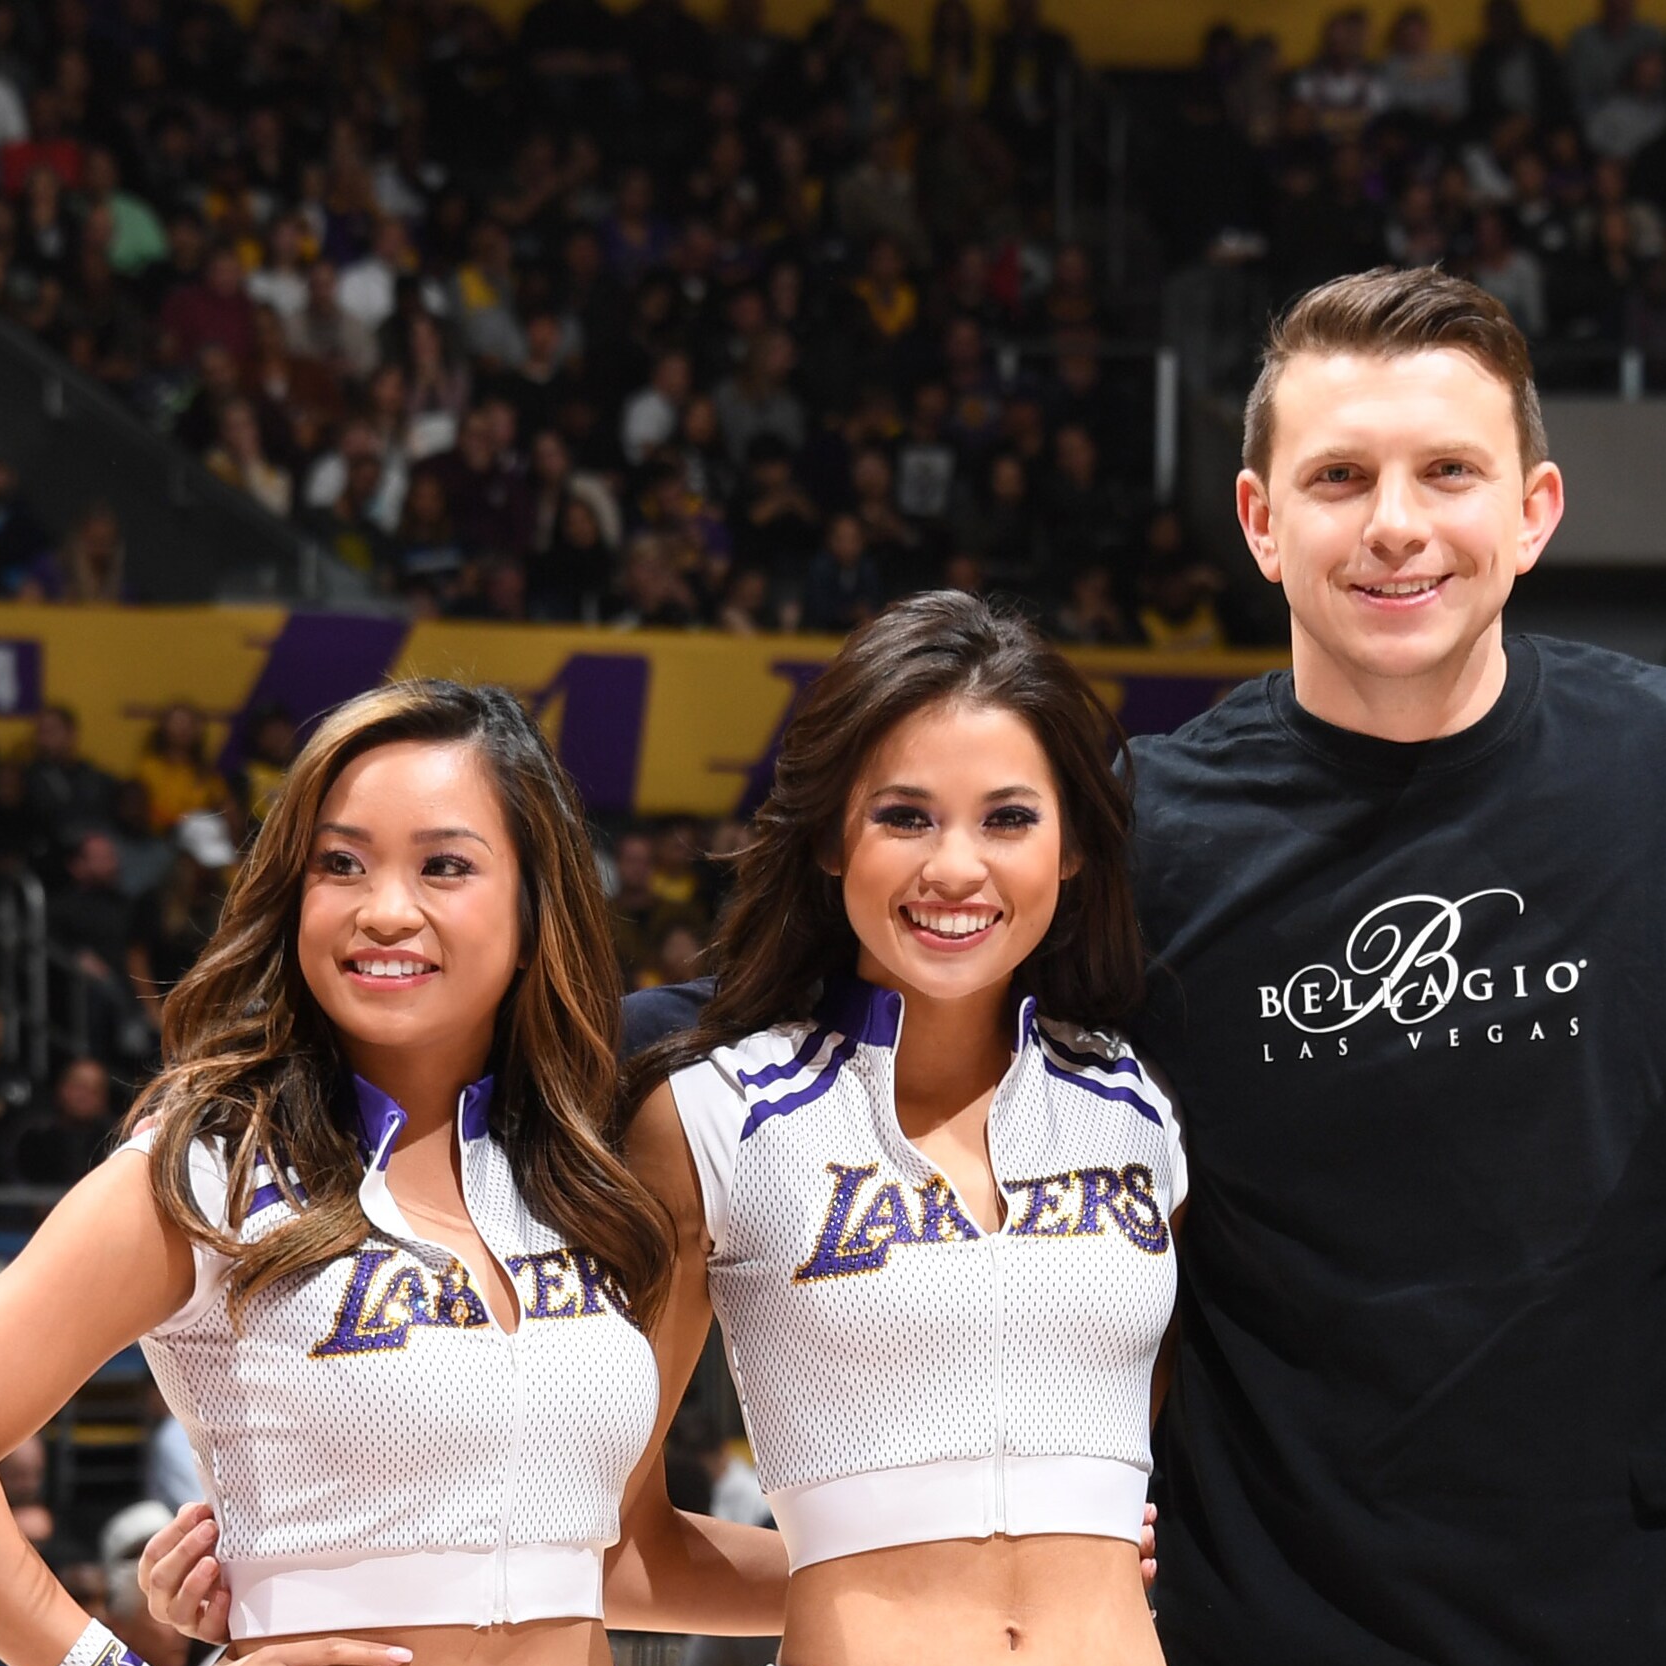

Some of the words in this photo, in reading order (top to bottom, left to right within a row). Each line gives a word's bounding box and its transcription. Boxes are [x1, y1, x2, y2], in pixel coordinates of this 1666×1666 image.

[1258, 960, 1581, 1019] BELLAGIO
[1263, 1037, 1349, 1063] LAS
[1406, 1017, 1581, 1051] VEGAS
[791, 1161, 1168, 1285] LAKERS
[307, 1247, 641, 1361] LAKER
